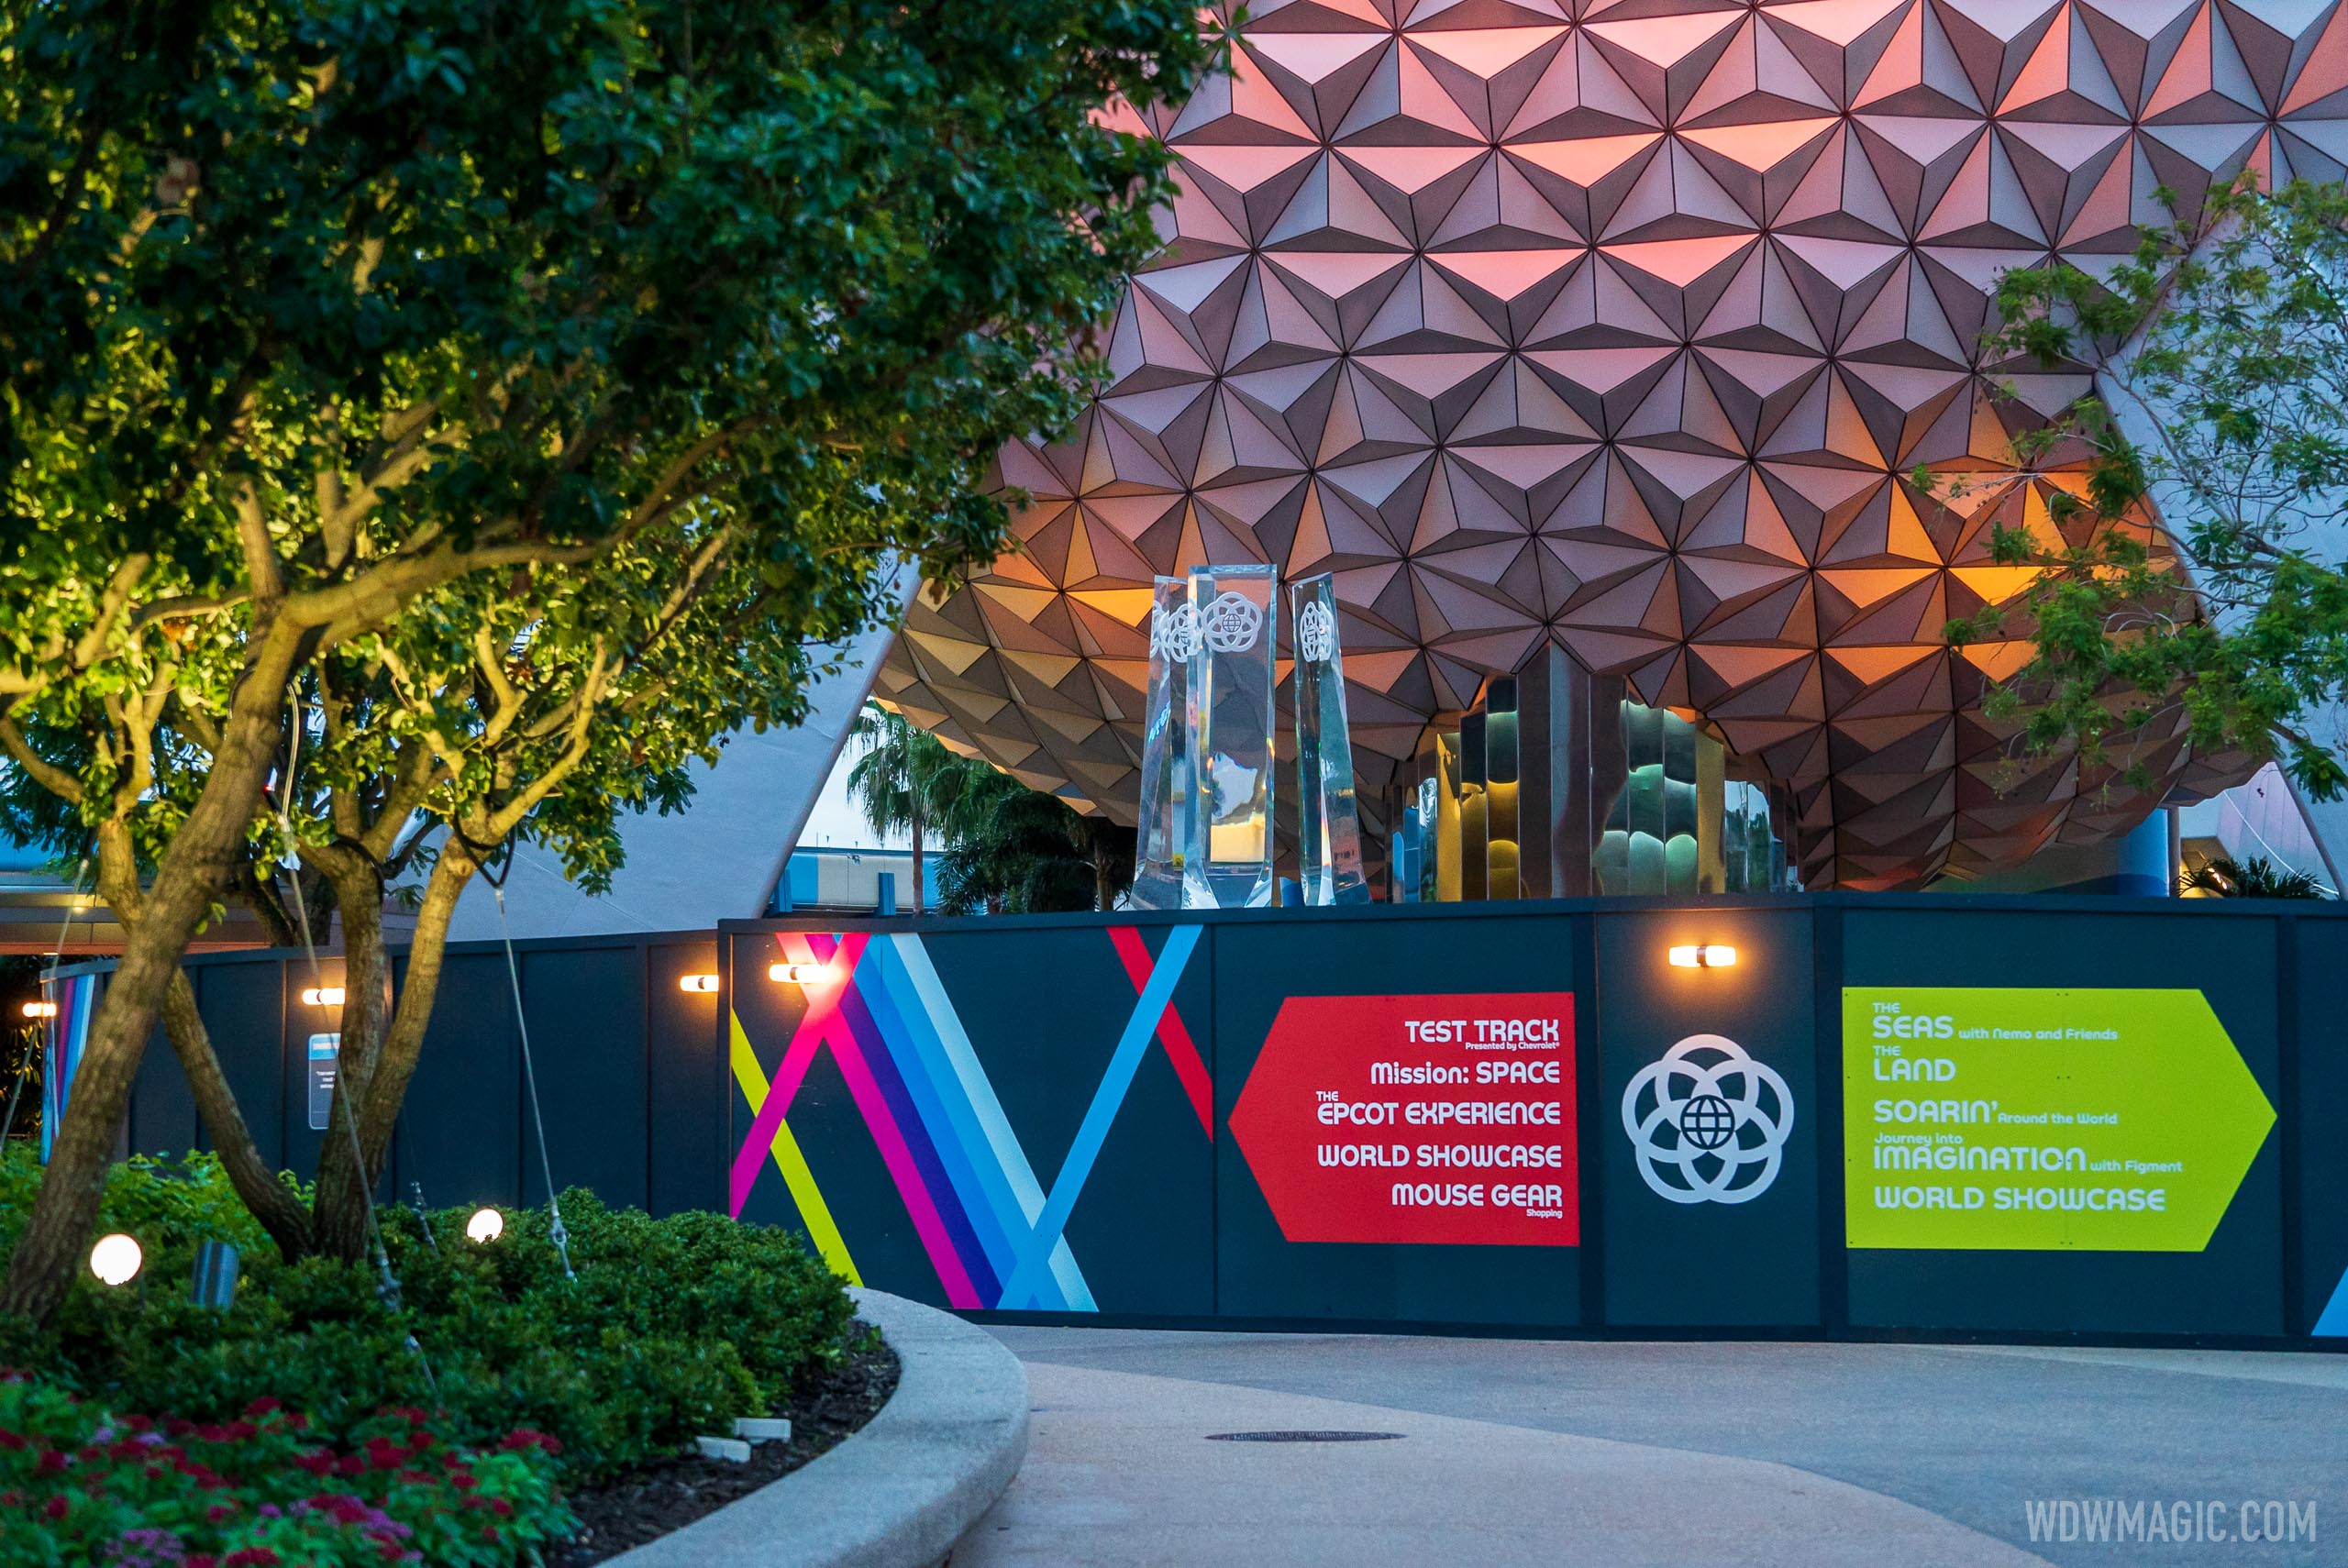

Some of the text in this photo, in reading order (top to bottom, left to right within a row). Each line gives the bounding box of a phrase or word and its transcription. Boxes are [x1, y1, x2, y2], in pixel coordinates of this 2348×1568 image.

[1873, 1002, 1899, 1013] THE
[1405, 1020, 1558, 1043] TEST TRACK
[1873, 1015, 2118, 1040] SEAS with Nemo and Friends
[1465, 1042, 1505, 1050] Presented
[1506, 1042, 1517, 1052] by
[1873, 1045, 1900, 1056] THE
[1371, 1062, 1559, 1084] Mission: SPACE
[1874, 1058, 1956, 1081] LAND
[1316, 1091, 1338, 1101] THE
[1318, 1102, 1560, 1124] EPCOT EXPERIENCE
[1998, 1112, 2047, 1123] Around
[2052, 1113, 2073, 1123] the
[2077, 1114, 2118, 1124] World
[1875, 1133, 1963, 1146] Journey into
[1318, 1145, 1561, 1167] WORLD SHOWCASE
[1874, 1145, 2182, 1174] IMAGINATION with Figment
[1392, 1184, 1562, 1207] MOUSE GEAR
[1875, 1187, 2165, 1210] WORLD SHOWCASE
[1527, 1209, 1562, 1219] Shopping
